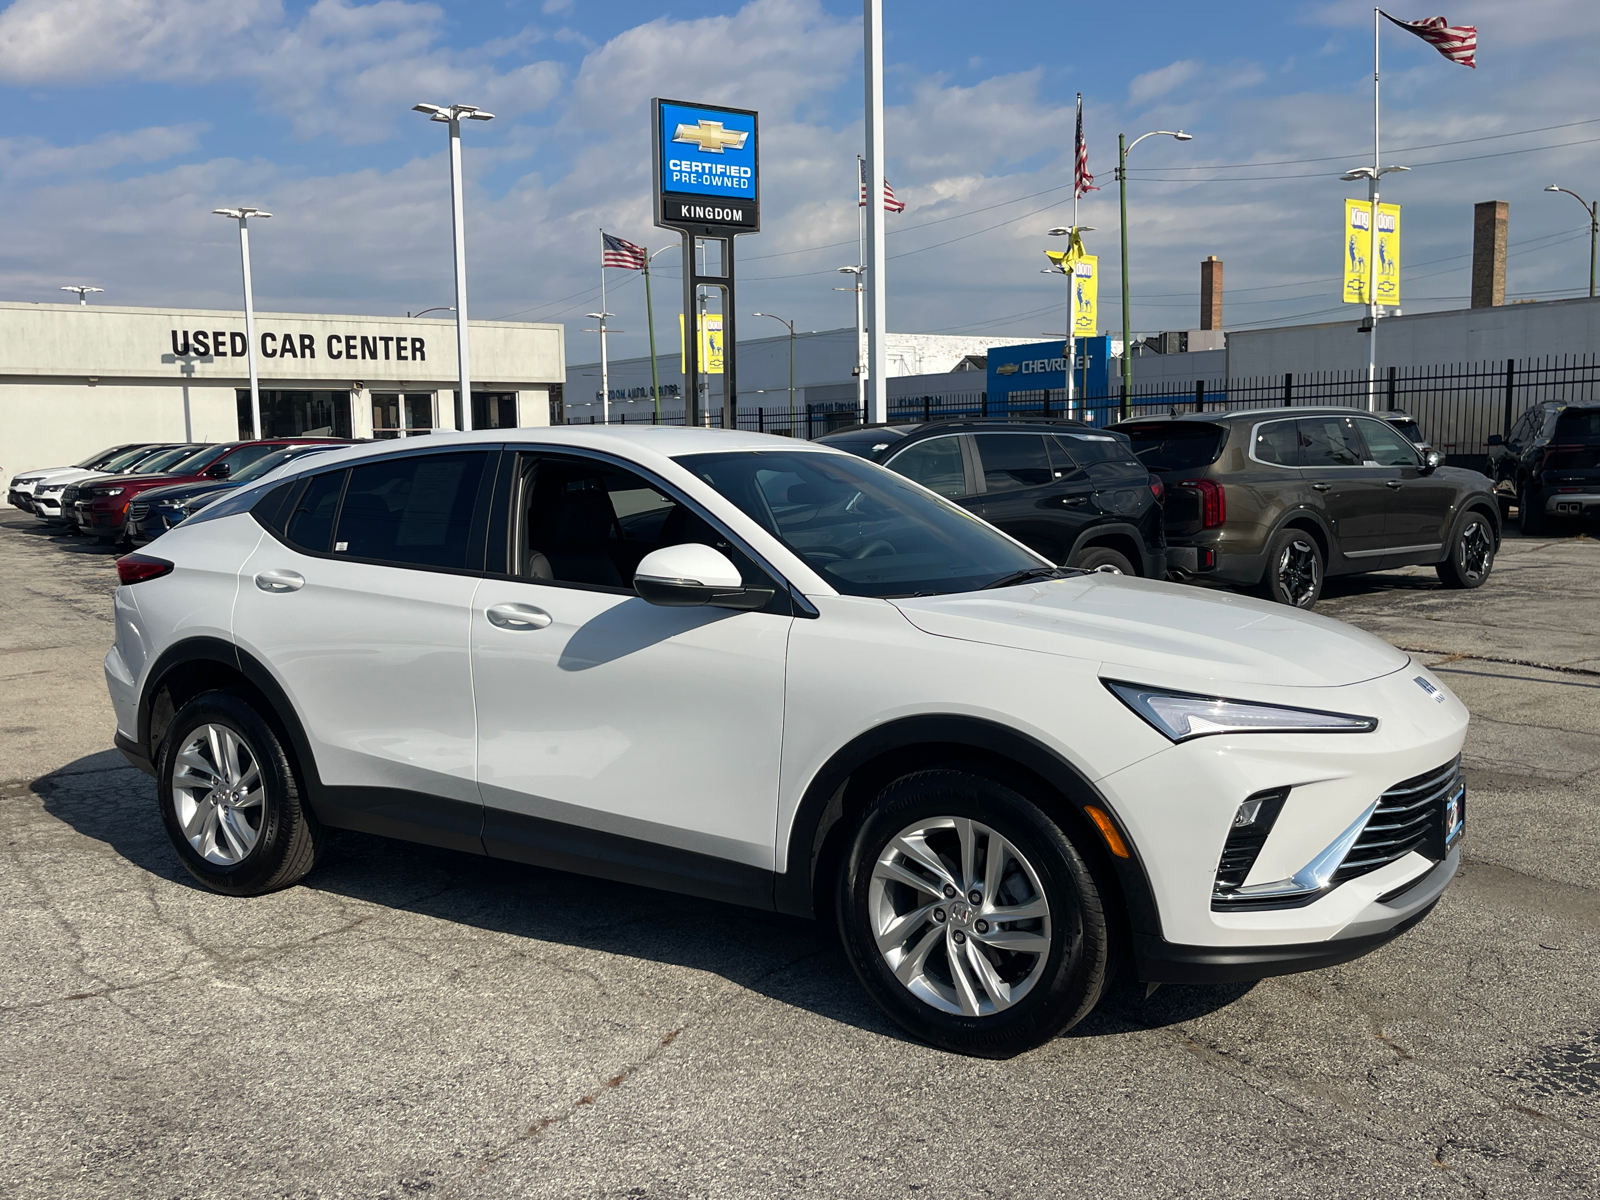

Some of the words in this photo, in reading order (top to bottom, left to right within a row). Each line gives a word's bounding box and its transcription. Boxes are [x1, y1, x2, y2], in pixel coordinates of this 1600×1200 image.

[669, 159, 751, 178] CERTIFIED
[673, 172, 748, 189] PRE-OWNED
[681, 205, 742, 221] KINGDOM
[1351, 207, 1369, 231] King
[1378, 211, 1395, 233] dom
[1076, 261, 1092, 278] dom
[171, 329, 247, 358] USED
[261, 332, 315, 359] CAR
[327, 334, 426, 361] CENTER
[1021, 354, 1093, 374] CHEVROET
